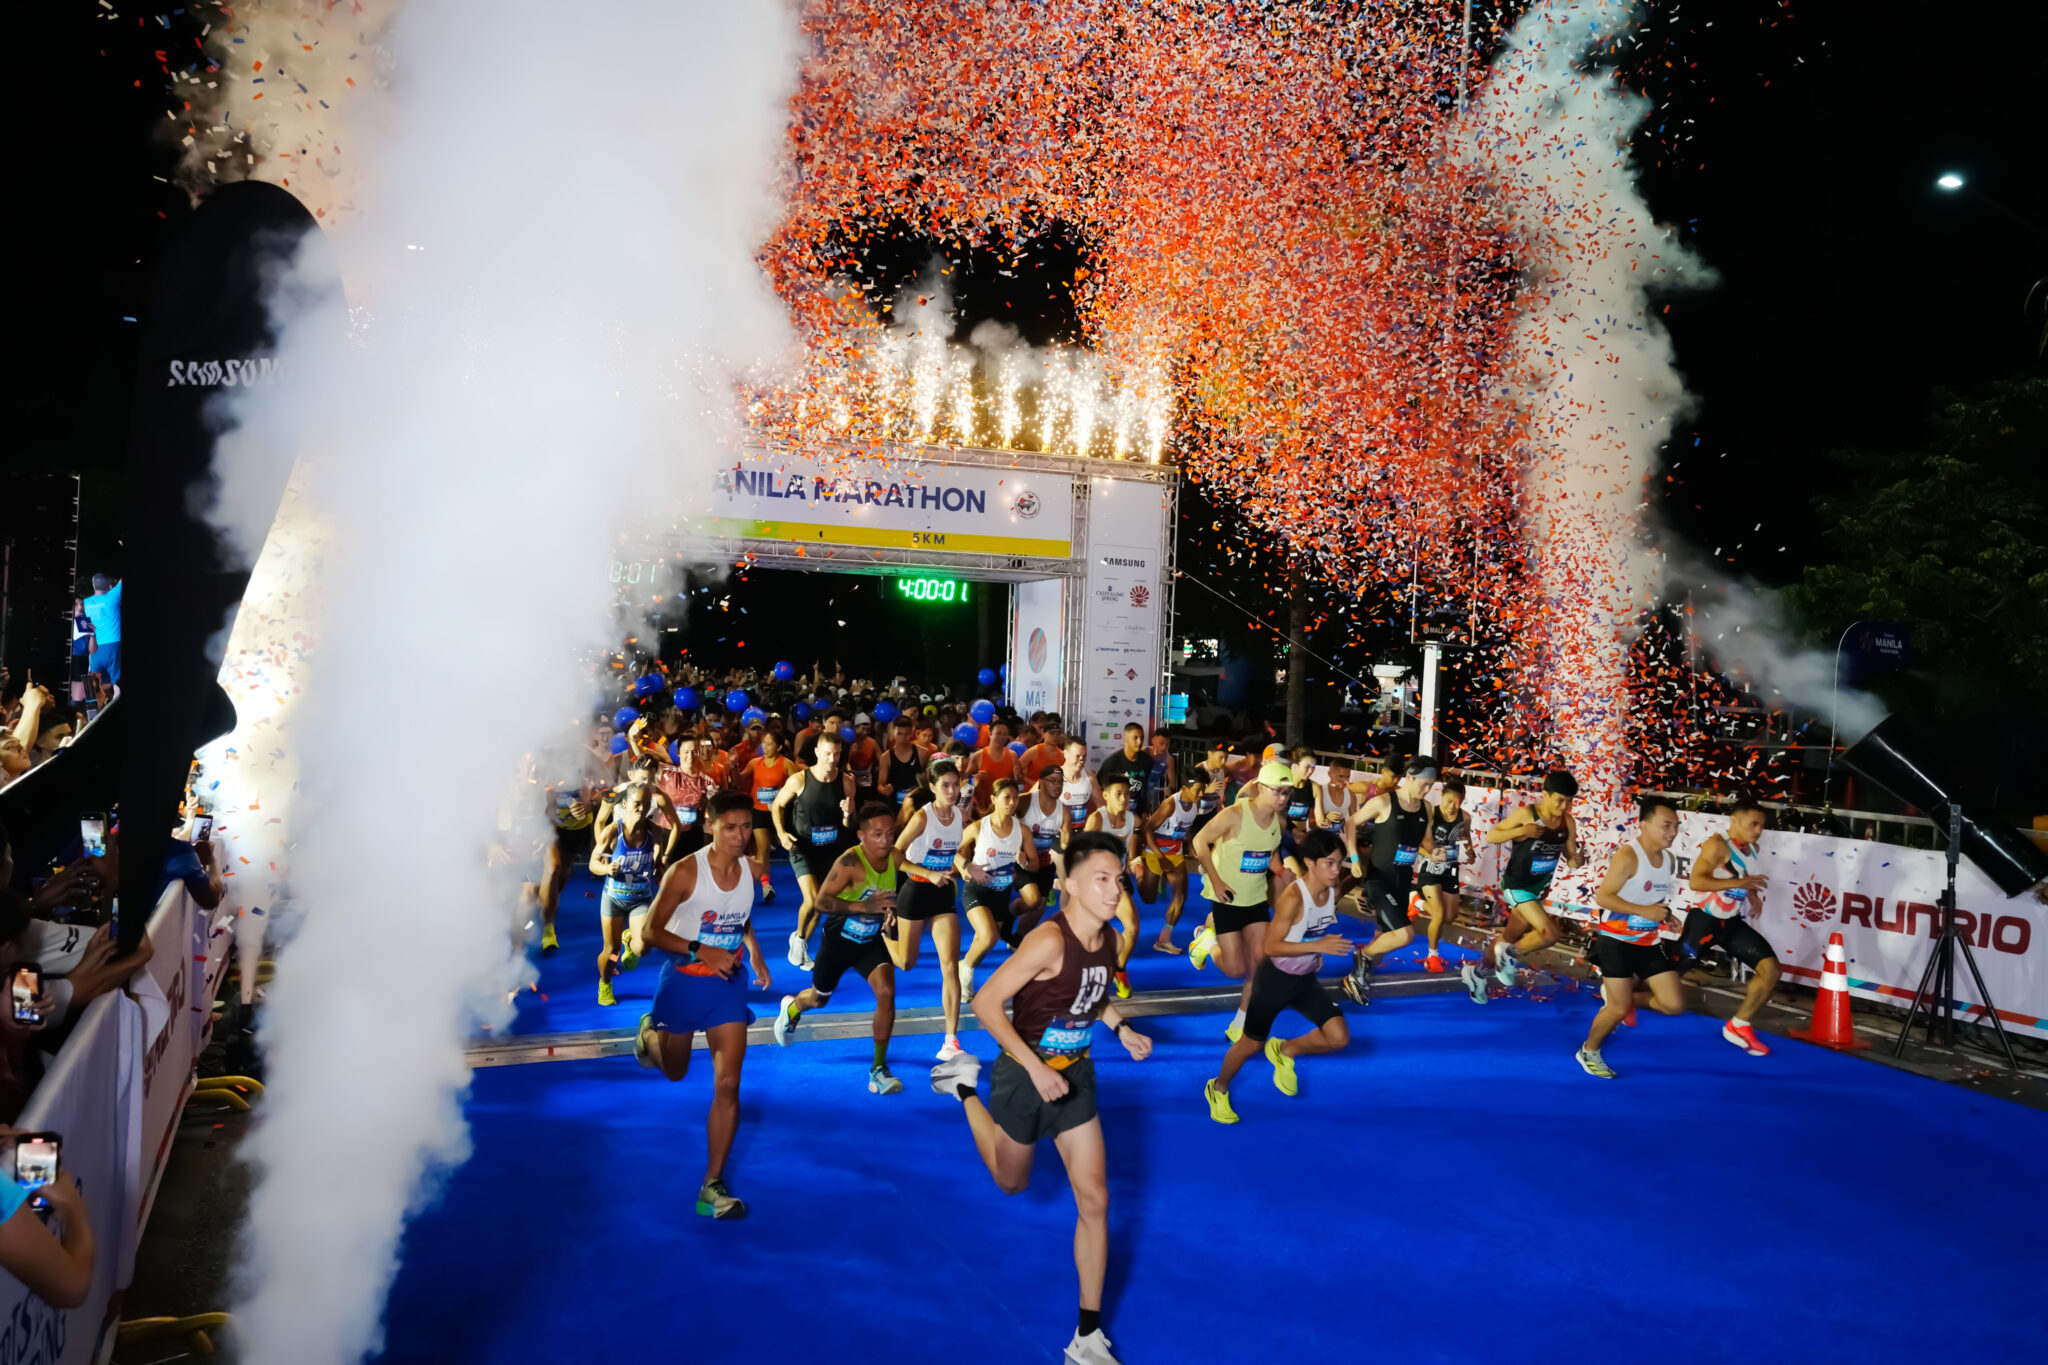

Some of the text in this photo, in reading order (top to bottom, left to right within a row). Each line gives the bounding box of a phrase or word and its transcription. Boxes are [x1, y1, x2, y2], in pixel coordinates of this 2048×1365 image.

[167, 358, 282, 387] SAMSUN
[712, 468, 986, 513] ANILA MARATHON
[1103, 557, 1146, 568] SAMSUNG
[1875, 637, 1903, 650] MANILA
